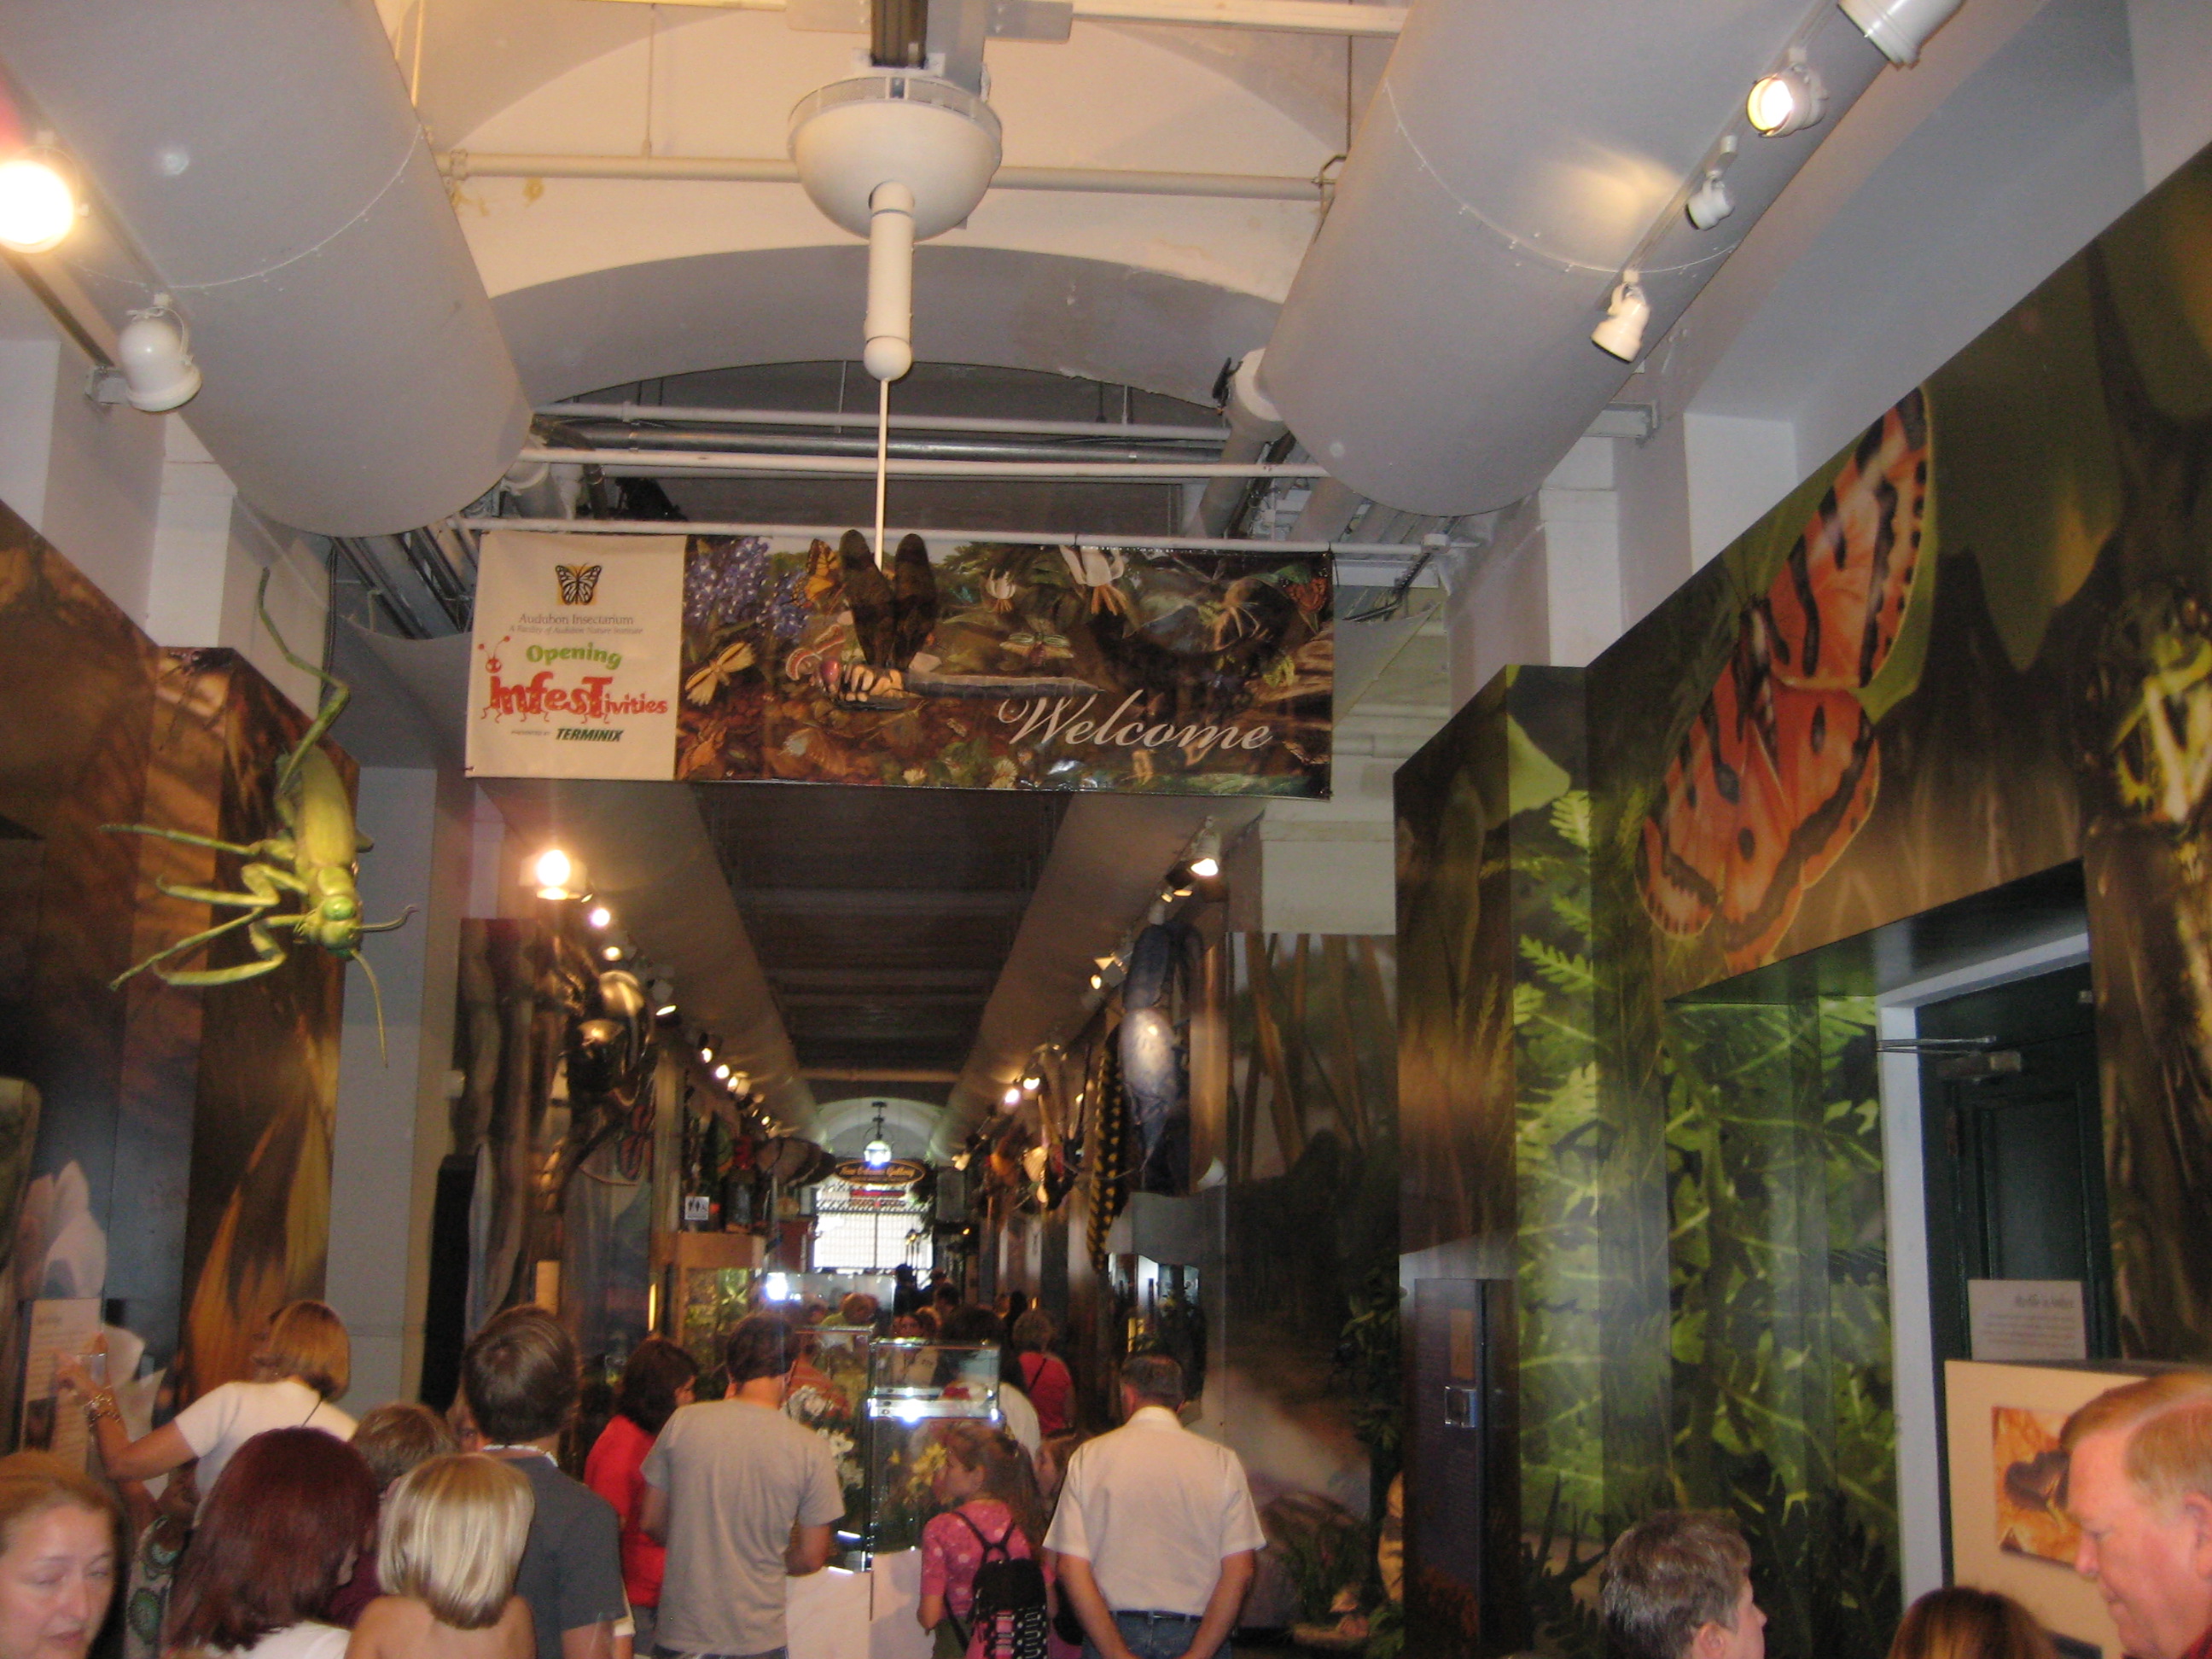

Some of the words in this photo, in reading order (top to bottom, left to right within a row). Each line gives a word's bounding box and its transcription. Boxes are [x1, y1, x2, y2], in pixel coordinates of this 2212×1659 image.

[518, 613, 569, 625] Audubon
[572, 614, 634, 626] Insectarium
[526, 642, 622, 670] Opening
[998, 689, 1274, 750] Welcome
[556, 728, 624, 742] TERMINIX
